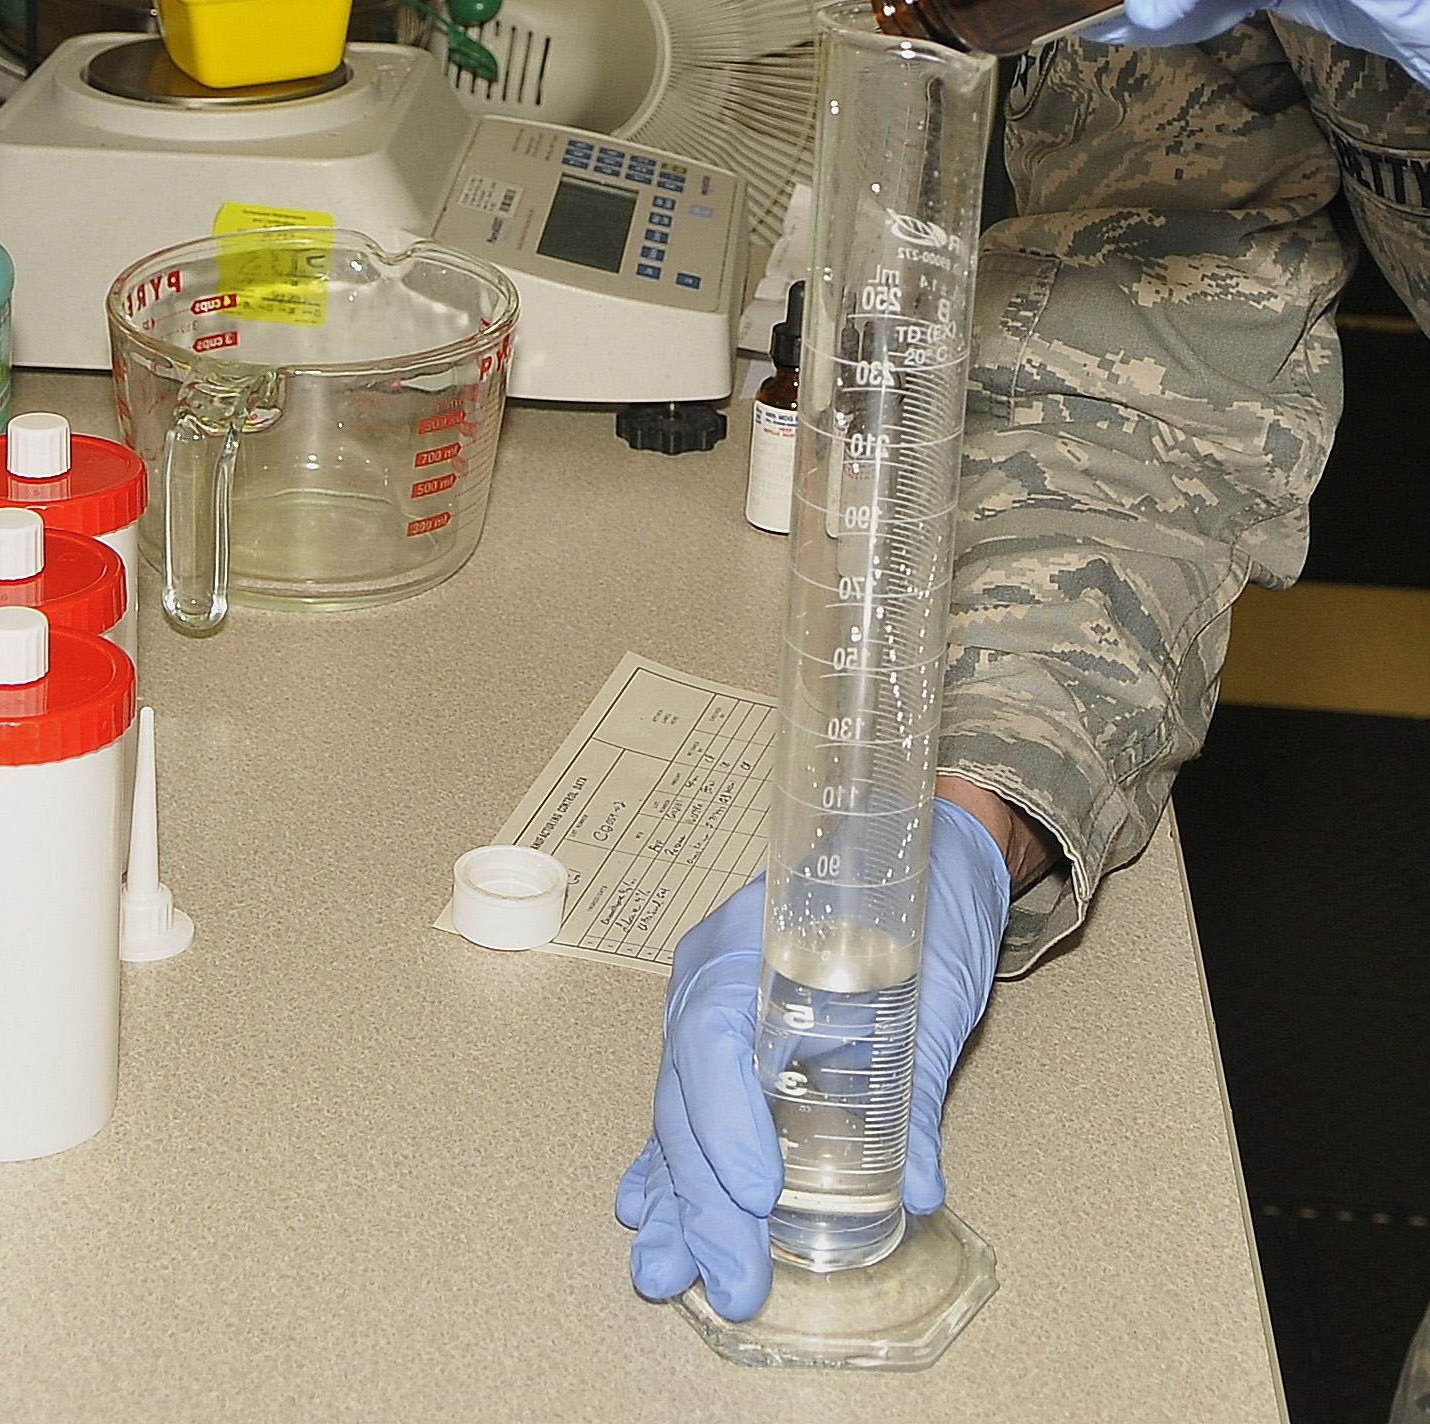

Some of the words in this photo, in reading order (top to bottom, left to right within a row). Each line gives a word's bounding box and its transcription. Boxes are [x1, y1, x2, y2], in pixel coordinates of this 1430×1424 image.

[896, 326, 921, 343] TD
[421, 450, 442, 465] 700
[417, 480, 438, 496] 500
[530, 808, 564, 851] ANUFACTURING
[556, 788, 579, 816] CONTROL
[573, 774, 589, 791] DATA
